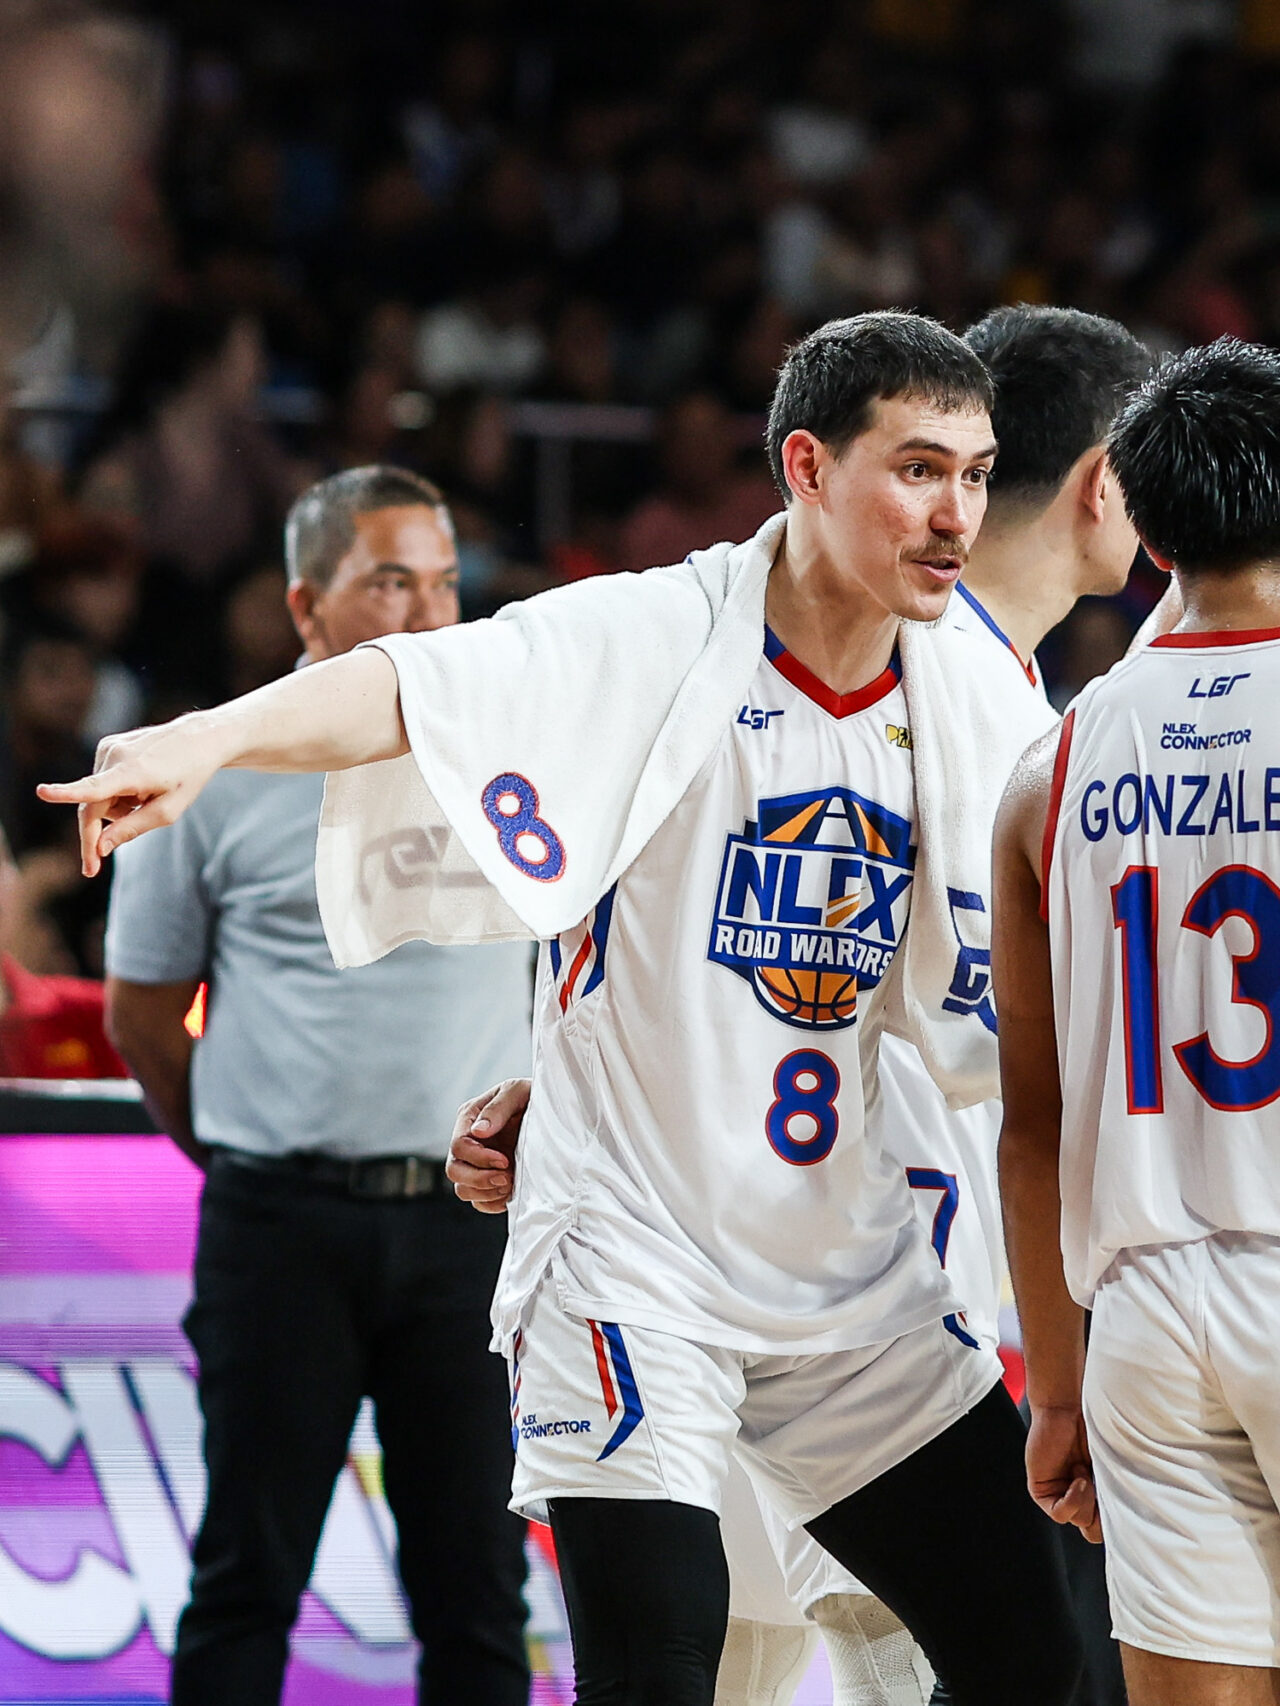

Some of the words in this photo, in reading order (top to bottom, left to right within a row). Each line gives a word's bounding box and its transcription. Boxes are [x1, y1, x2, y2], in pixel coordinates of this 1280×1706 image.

[1160, 729, 1251, 750] CONNECTOR
[1162, 723, 1197, 734] NLEX
[482, 772, 567, 883] 8
[724, 848, 913, 943] NLEX
[715, 925, 781, 960] ROAD
[765, 1048, 840, 1166] 8
[905, 1167, 959, 1270] 7
[521, 1420, 591, 1439] CONNECTOR
